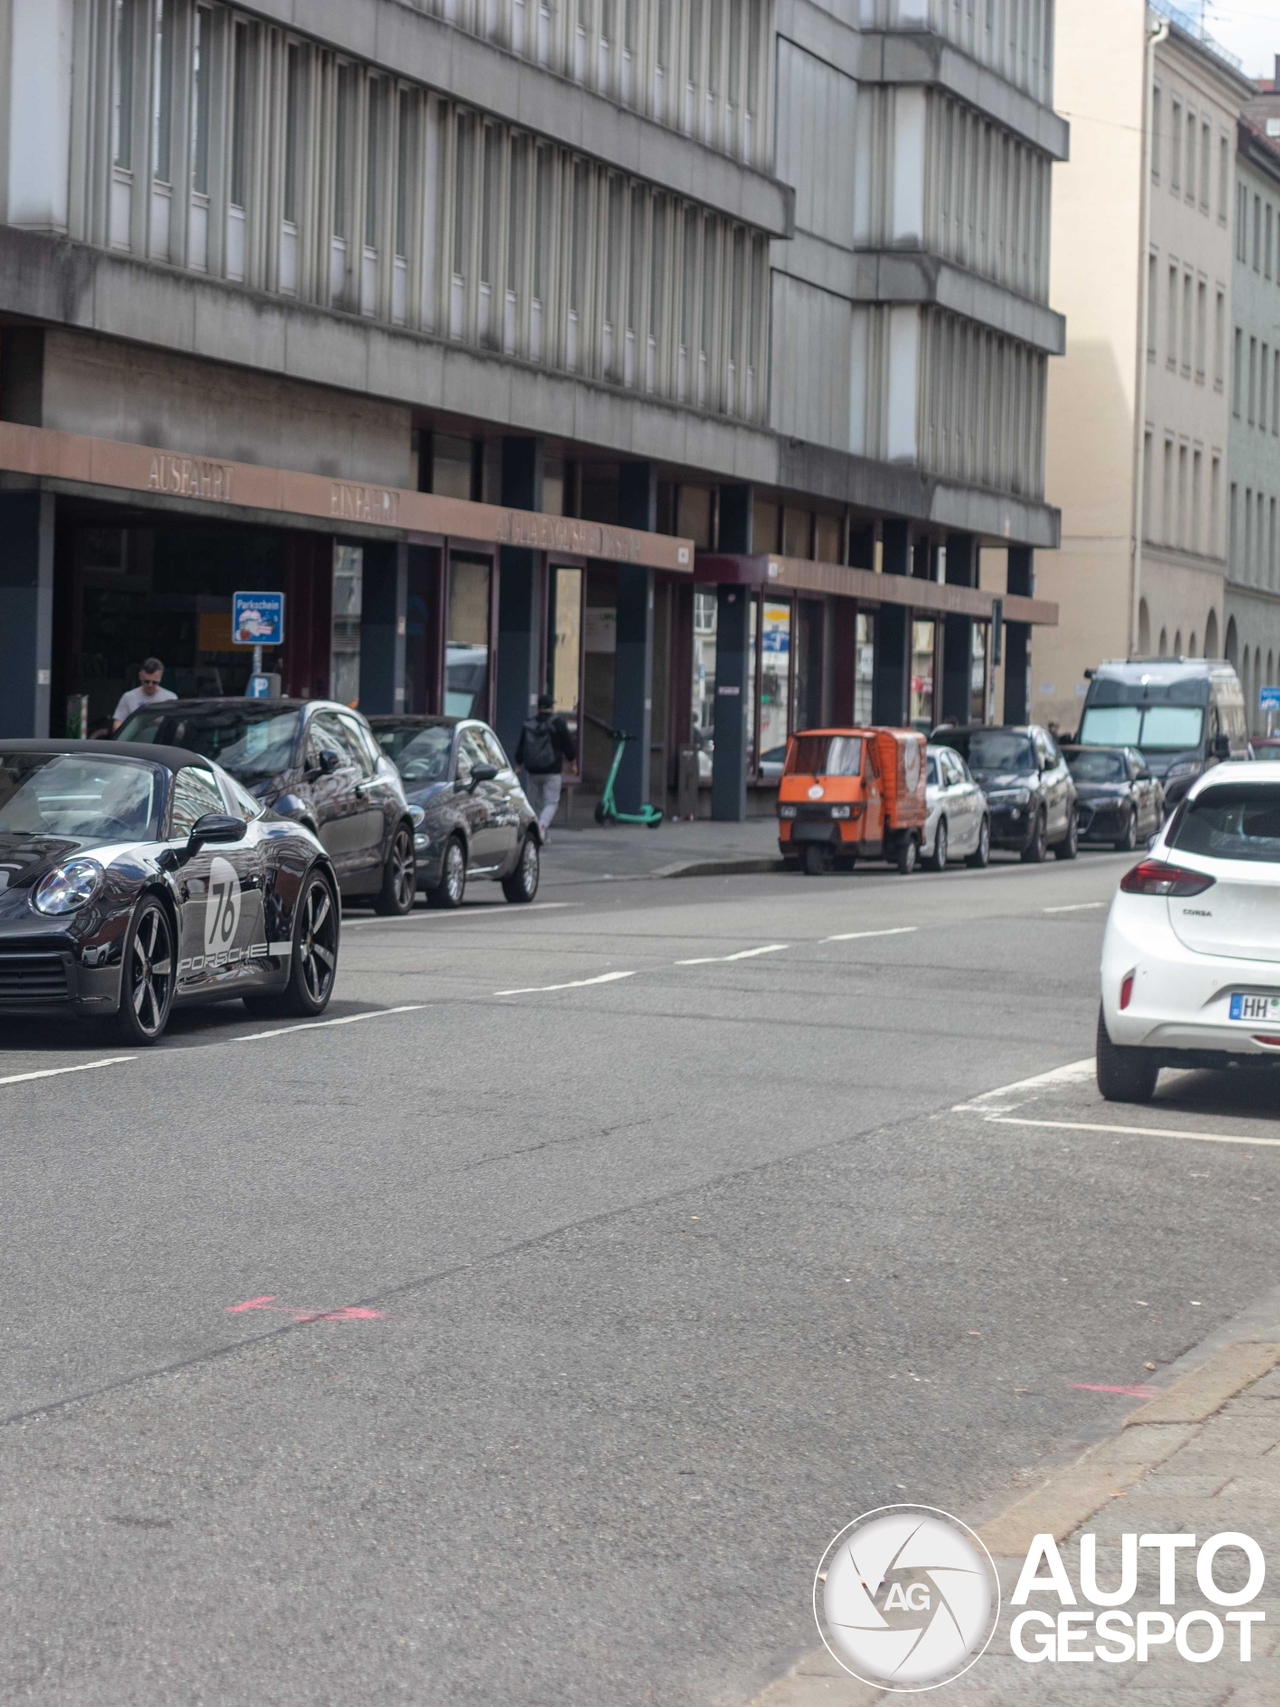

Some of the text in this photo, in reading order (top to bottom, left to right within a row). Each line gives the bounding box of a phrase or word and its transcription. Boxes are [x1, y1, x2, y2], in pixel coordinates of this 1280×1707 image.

[147, 454, 235, 500] AUSFAHRT
[330, 482, 401, 524] EINFAHRT
[237, 598, 280, 611] Parkschein
[208, 880, 236, 945] 76
[177, 942, 268, 974] PORSCHE
[1243, 997, 1268, 1018] HH
